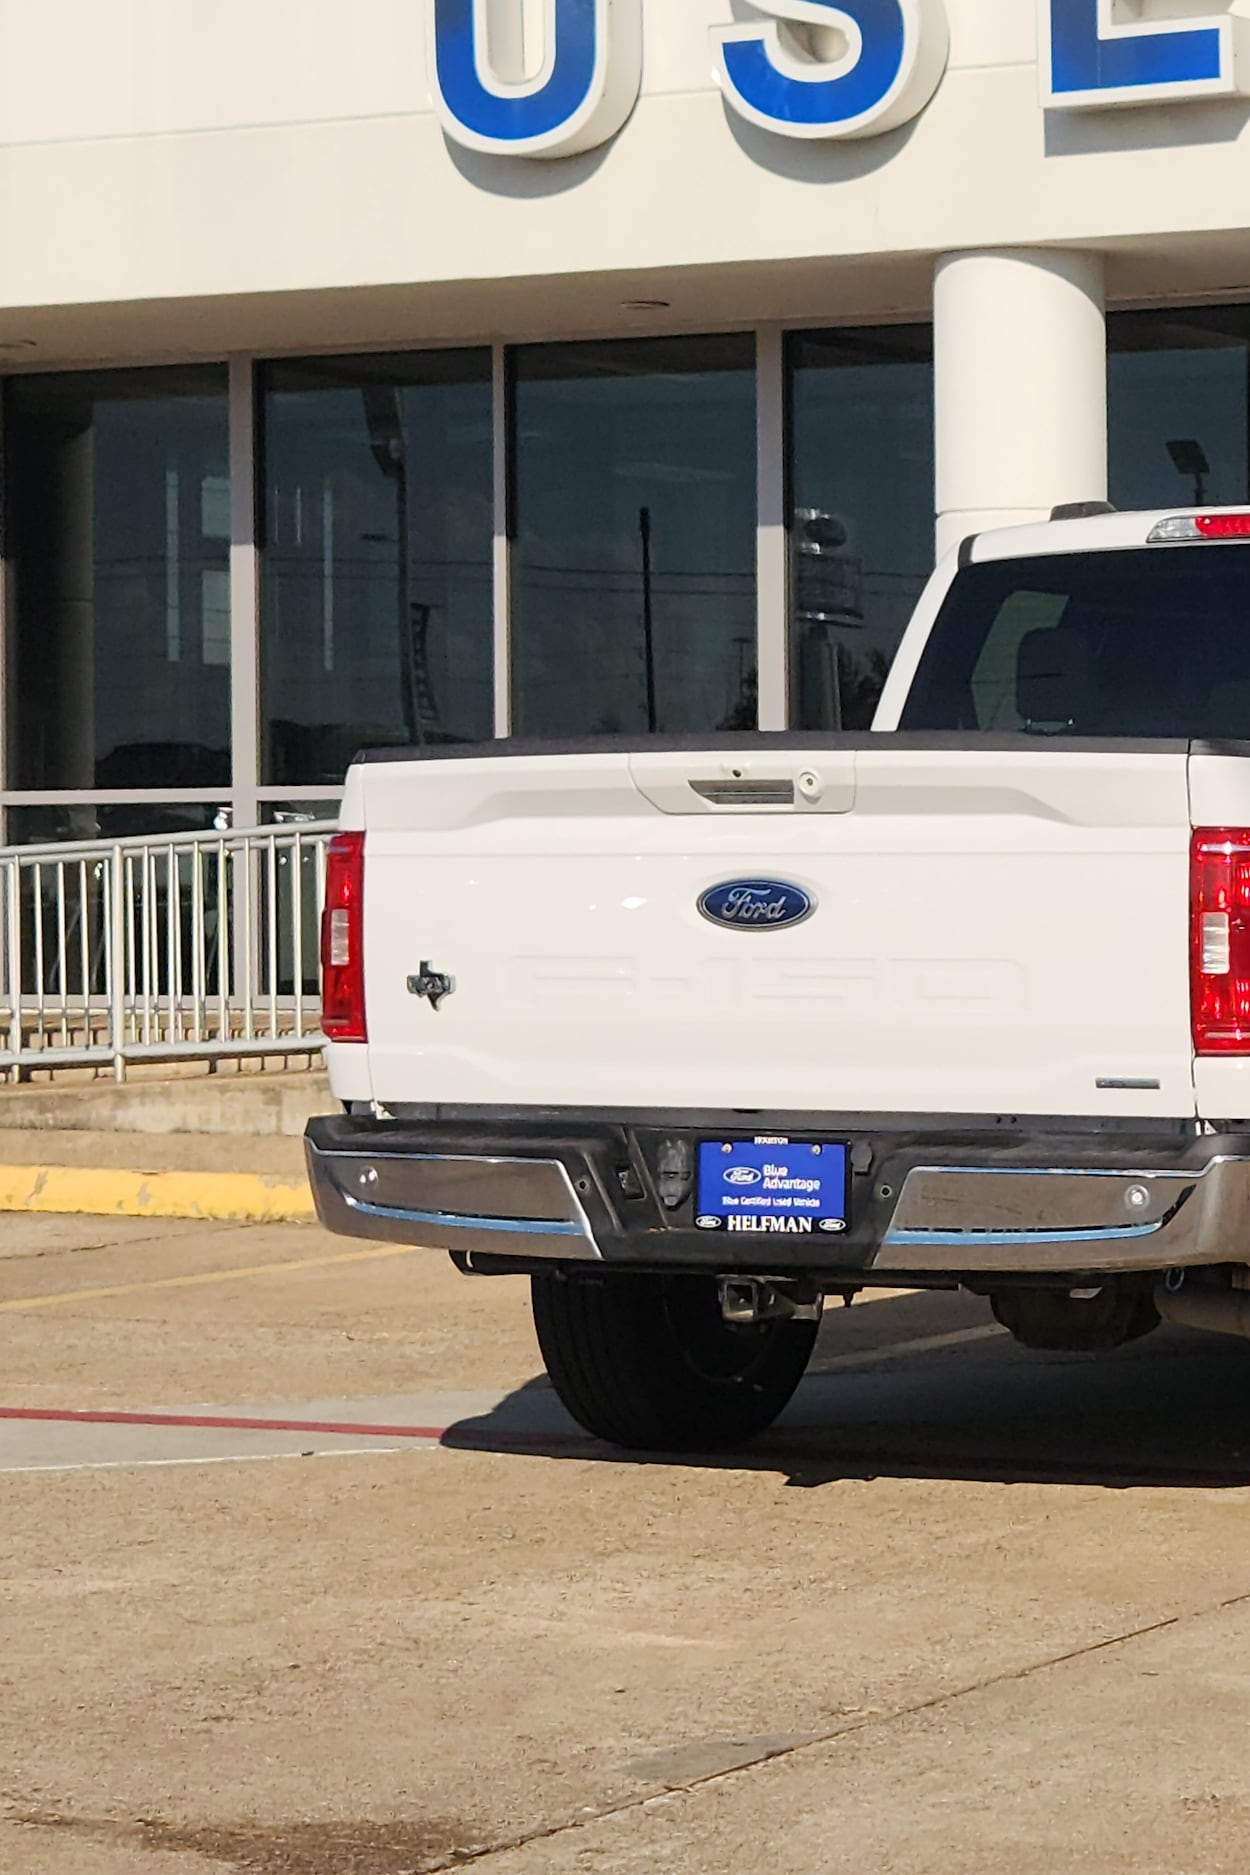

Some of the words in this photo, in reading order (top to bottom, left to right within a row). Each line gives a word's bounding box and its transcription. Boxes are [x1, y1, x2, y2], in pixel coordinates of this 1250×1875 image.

[721, 887, 787, 919] Ford
[763, 1164, 788, 1177] Blue
[763, 1178, 821, 1192] Advantage
[727, 1215, 813, 1233] HELFMAN
